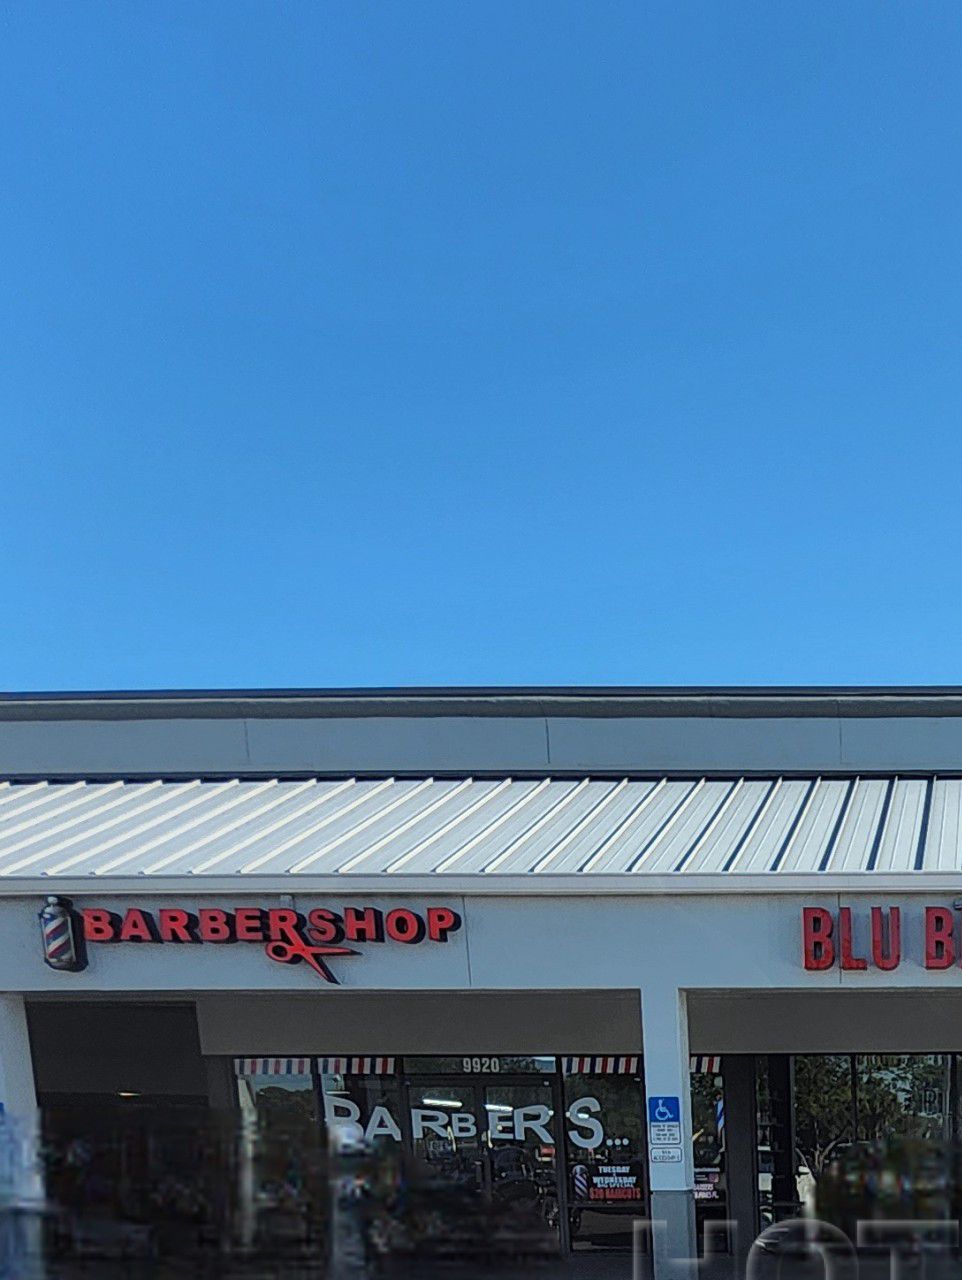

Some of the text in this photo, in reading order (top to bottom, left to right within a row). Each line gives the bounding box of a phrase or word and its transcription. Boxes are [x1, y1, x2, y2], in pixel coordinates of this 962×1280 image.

[84, 908, 460, 944] BARBERSHOP
[803, 906, 899, 970] BLU
[463, 1057, 500, 1073] 9920
